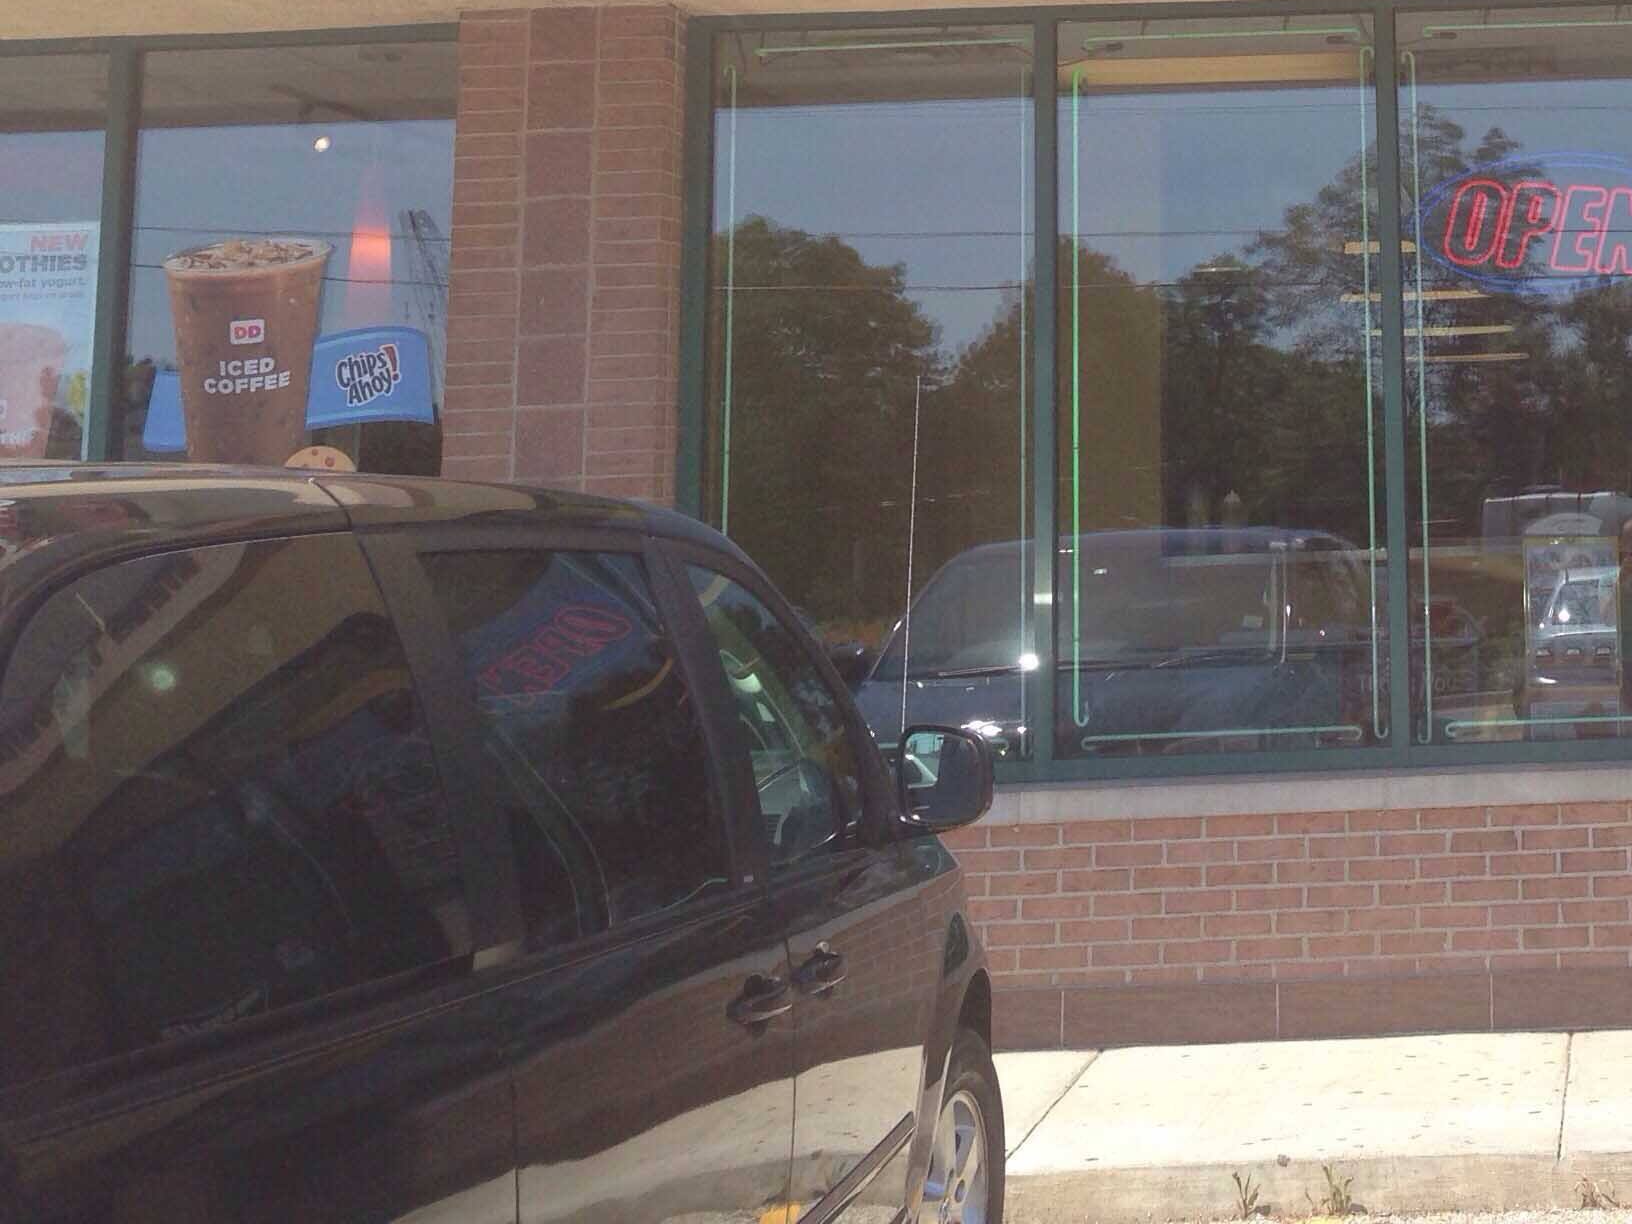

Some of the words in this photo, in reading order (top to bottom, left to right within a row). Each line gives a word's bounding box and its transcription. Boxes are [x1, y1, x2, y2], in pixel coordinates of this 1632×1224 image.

[30, 233, 88, 253] NEW
[233, 325, 262, 340] DD
[219, 357, 275, 376] ICED
[337, 350, 387, 388] Chips
[204, 371, 291, 394] COFFEE
